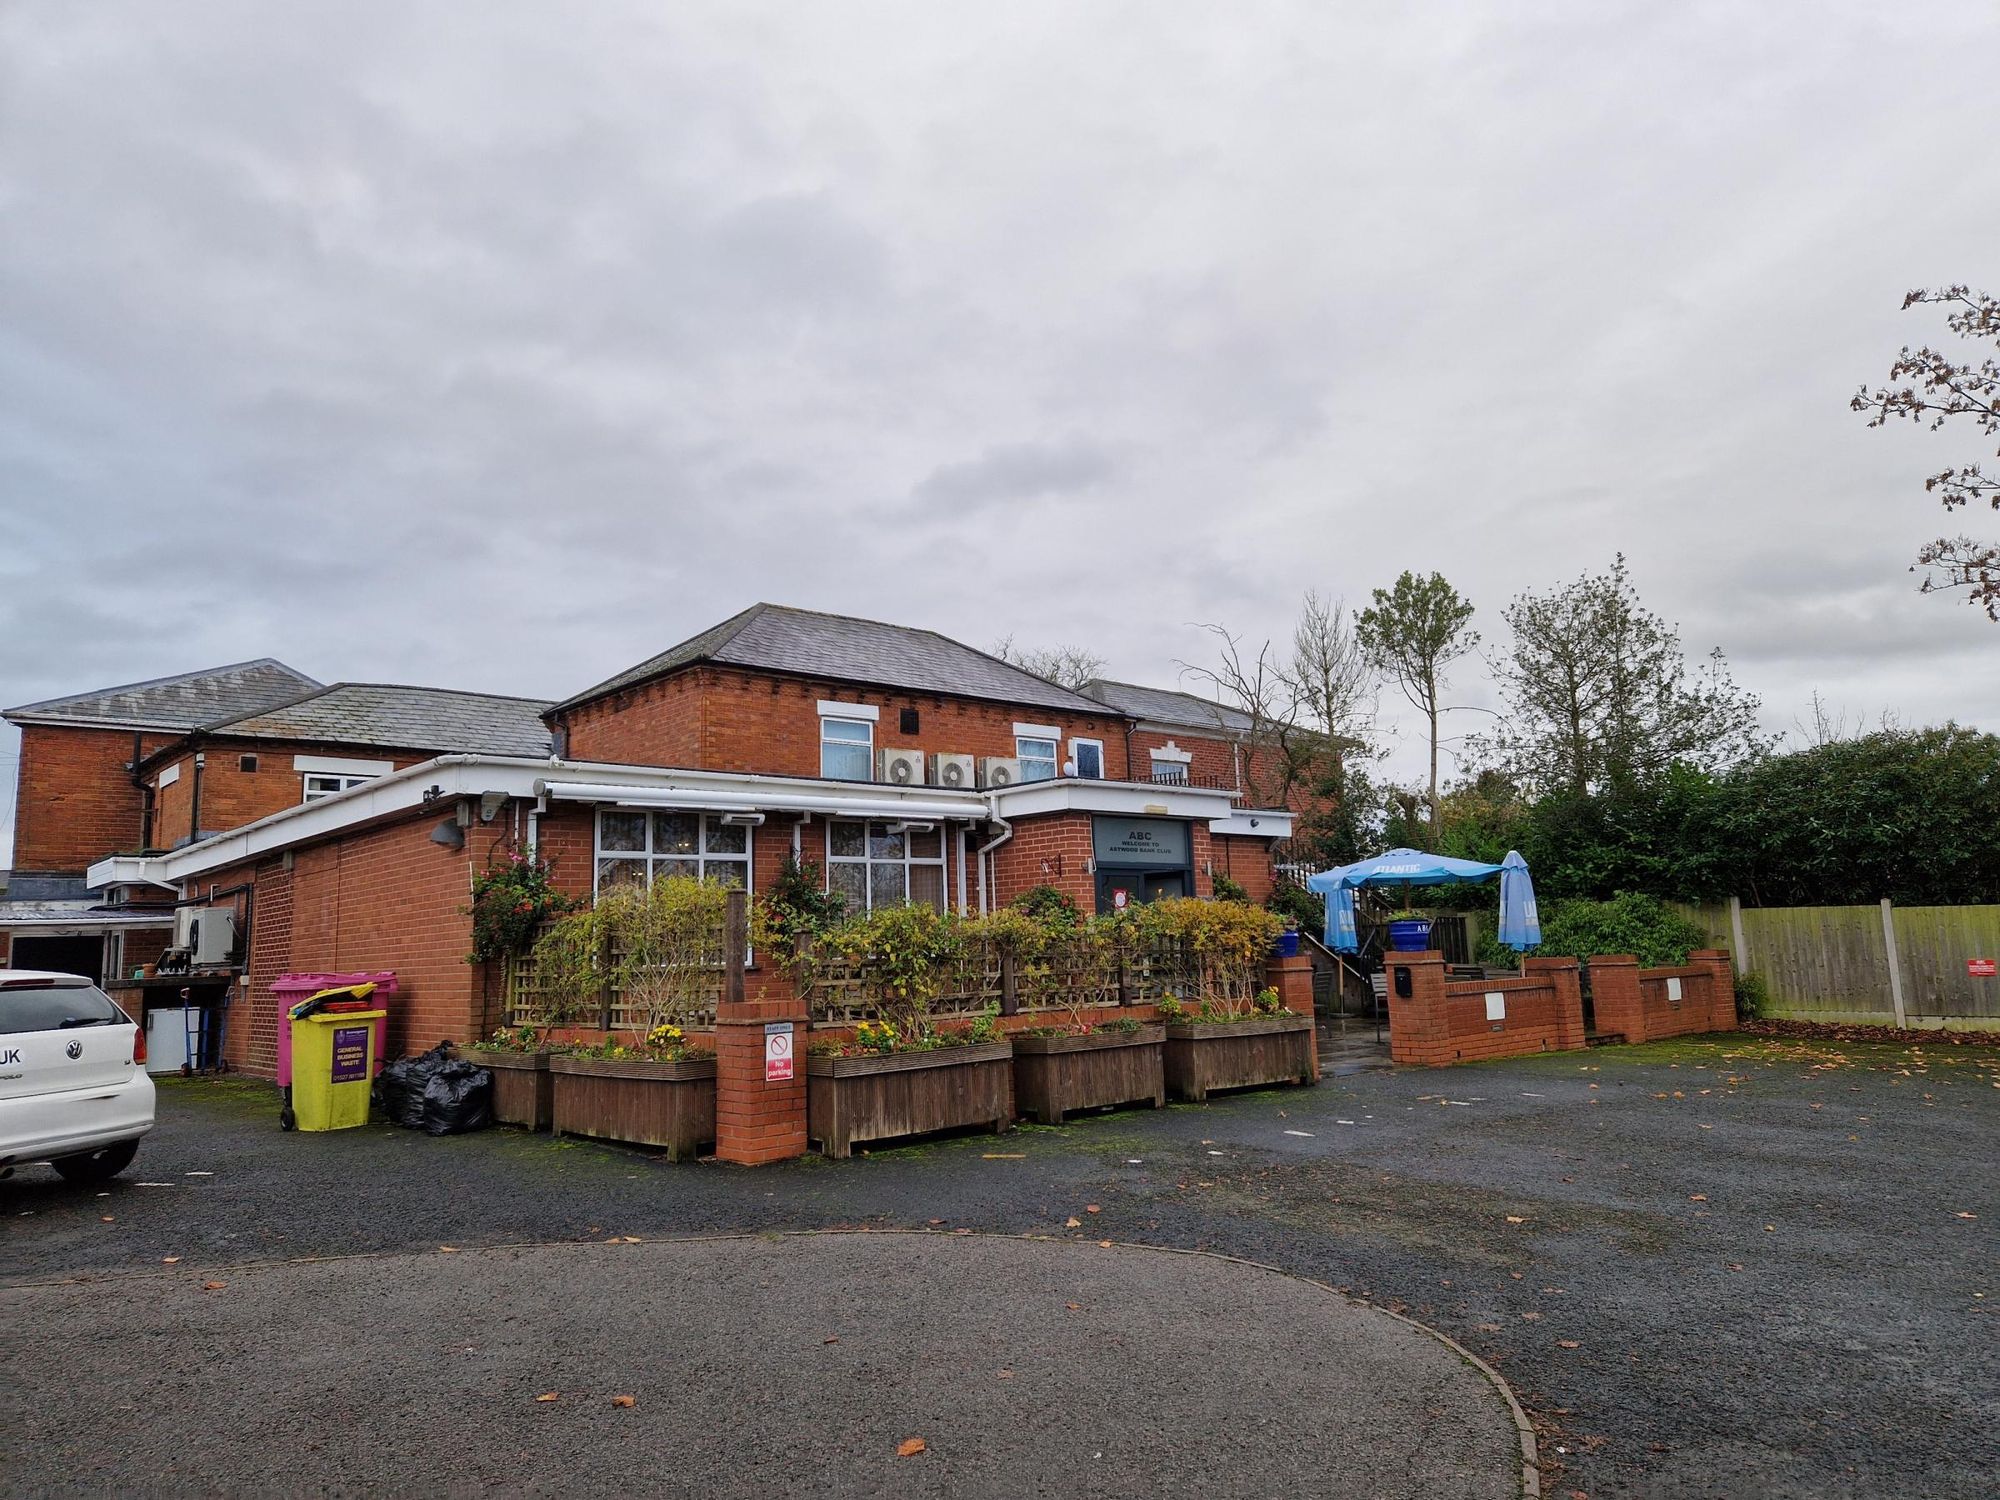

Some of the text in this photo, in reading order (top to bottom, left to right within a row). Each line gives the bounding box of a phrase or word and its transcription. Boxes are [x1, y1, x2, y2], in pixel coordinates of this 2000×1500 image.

[1129, 831, 1152, 840] ABC
[337, 1052, 364, 1060] BUSINESS
[768, 1069, 791, 1078] parking
